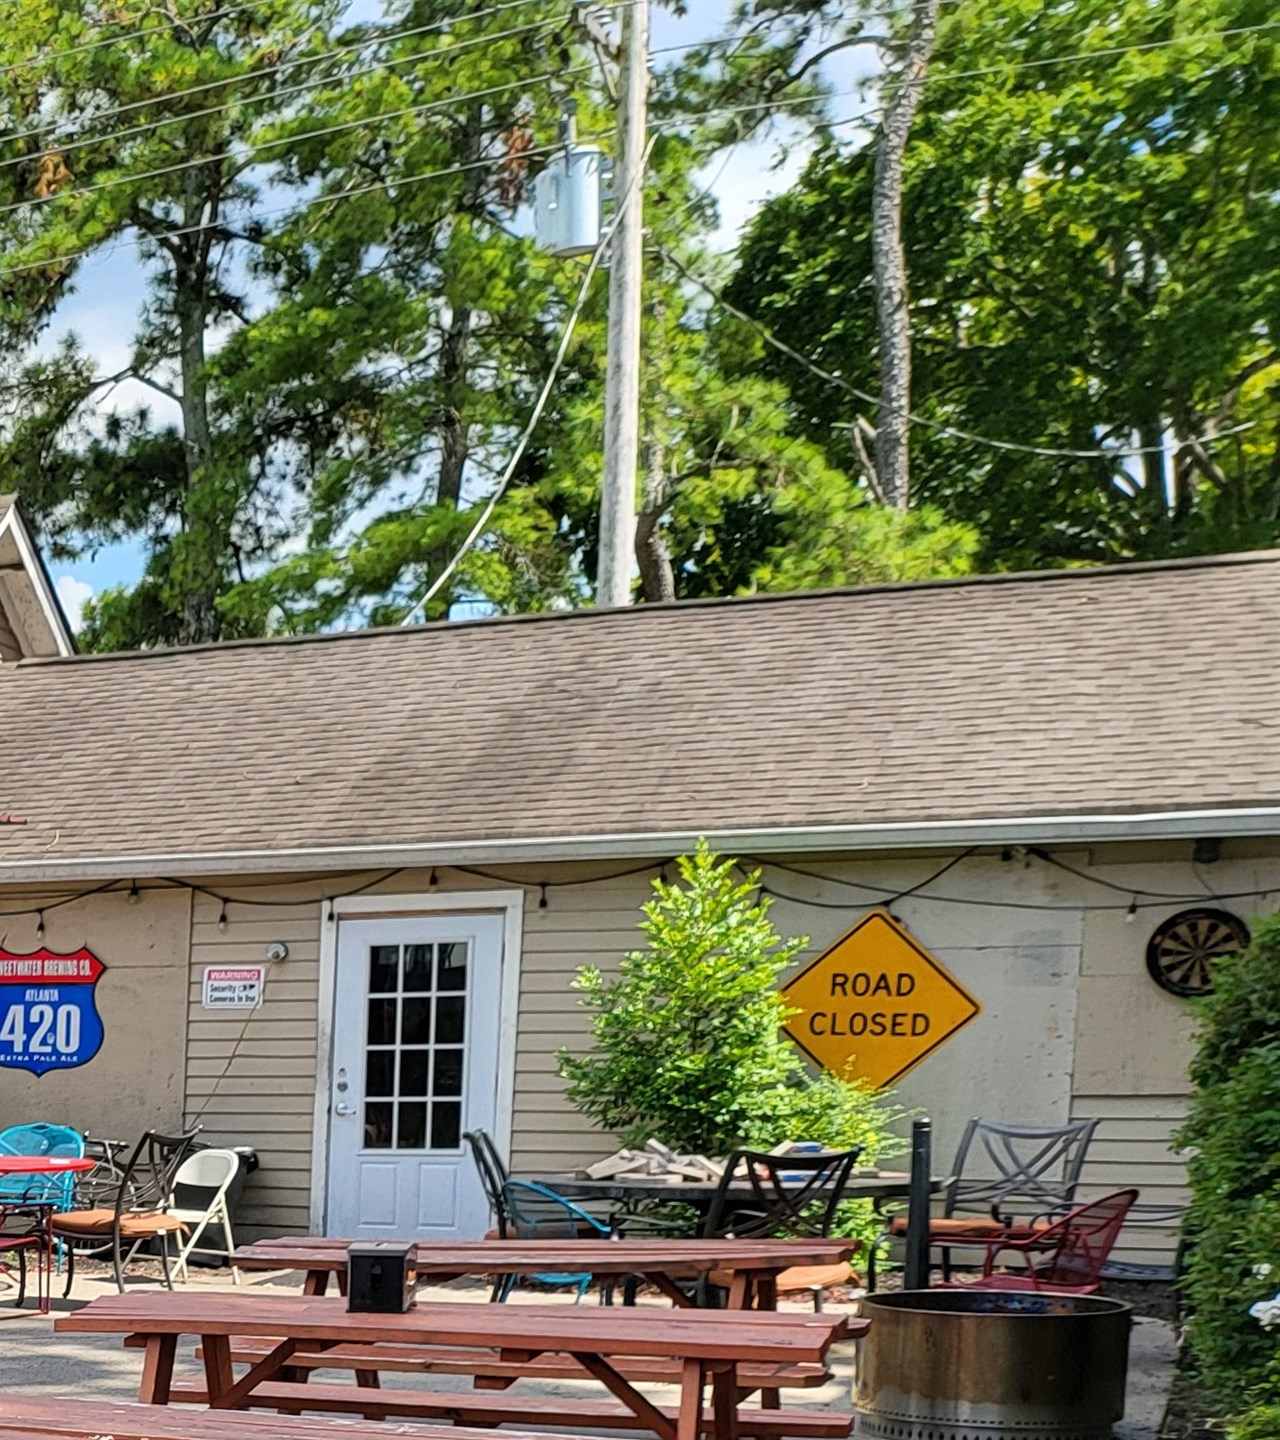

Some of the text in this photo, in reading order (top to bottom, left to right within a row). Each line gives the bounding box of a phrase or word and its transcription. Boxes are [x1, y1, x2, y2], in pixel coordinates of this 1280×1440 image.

[43, 959, 78, 976] BREWING
[79, 958, 93, 976] CO.
[210, 970, 258, 980] WARNING
[210, 983, 236, 994] Security
[830, 973, 916, 997] ROAD
[24, 988, 59, 1002] ATLANTA
[0, 1004, 80, 1053] 420
[809, 1012, 930, 1036] CLOSED
